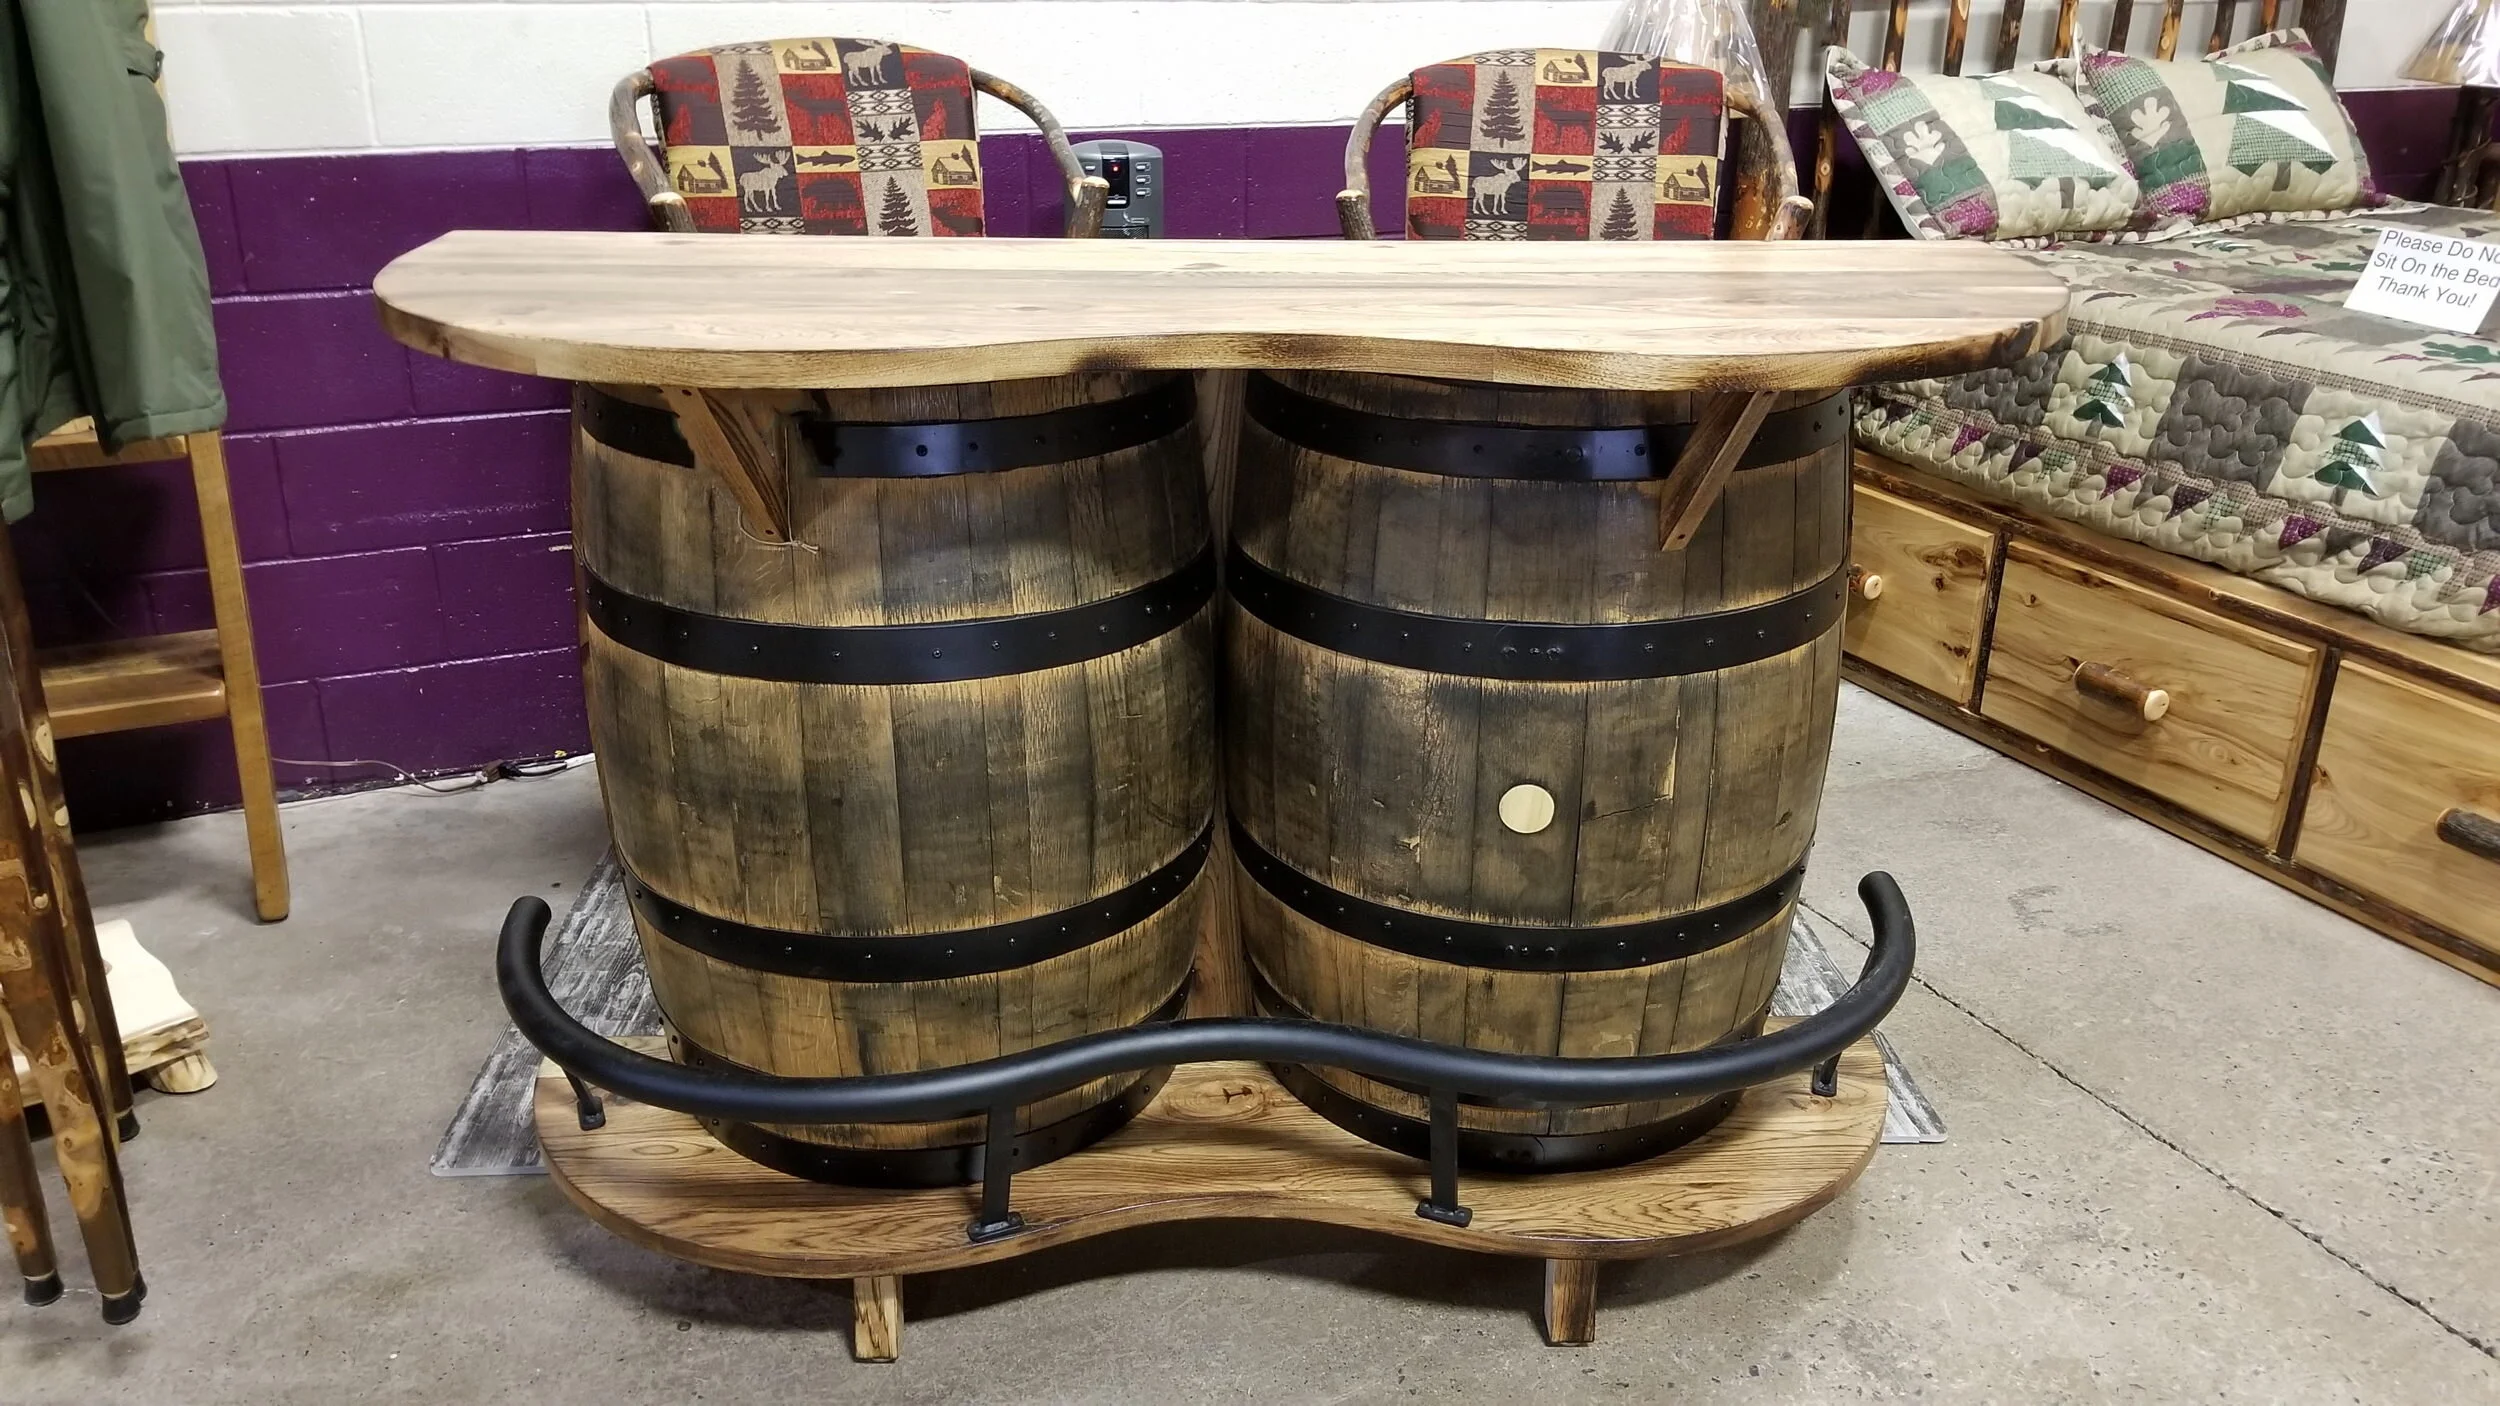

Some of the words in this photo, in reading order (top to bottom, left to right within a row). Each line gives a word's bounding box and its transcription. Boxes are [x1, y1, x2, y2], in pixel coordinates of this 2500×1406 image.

[2383, 230, 2442, 253] Please
[2447, 241, 2474, 259] Do
[2373, 252, 2397, 270] Sit
[2401, 257, 2427, 275] On
[2431, 263, 2459, 280] the
[2377, 275, 2430, 299] Thank
[2436, 286, 2477, 308] You!
